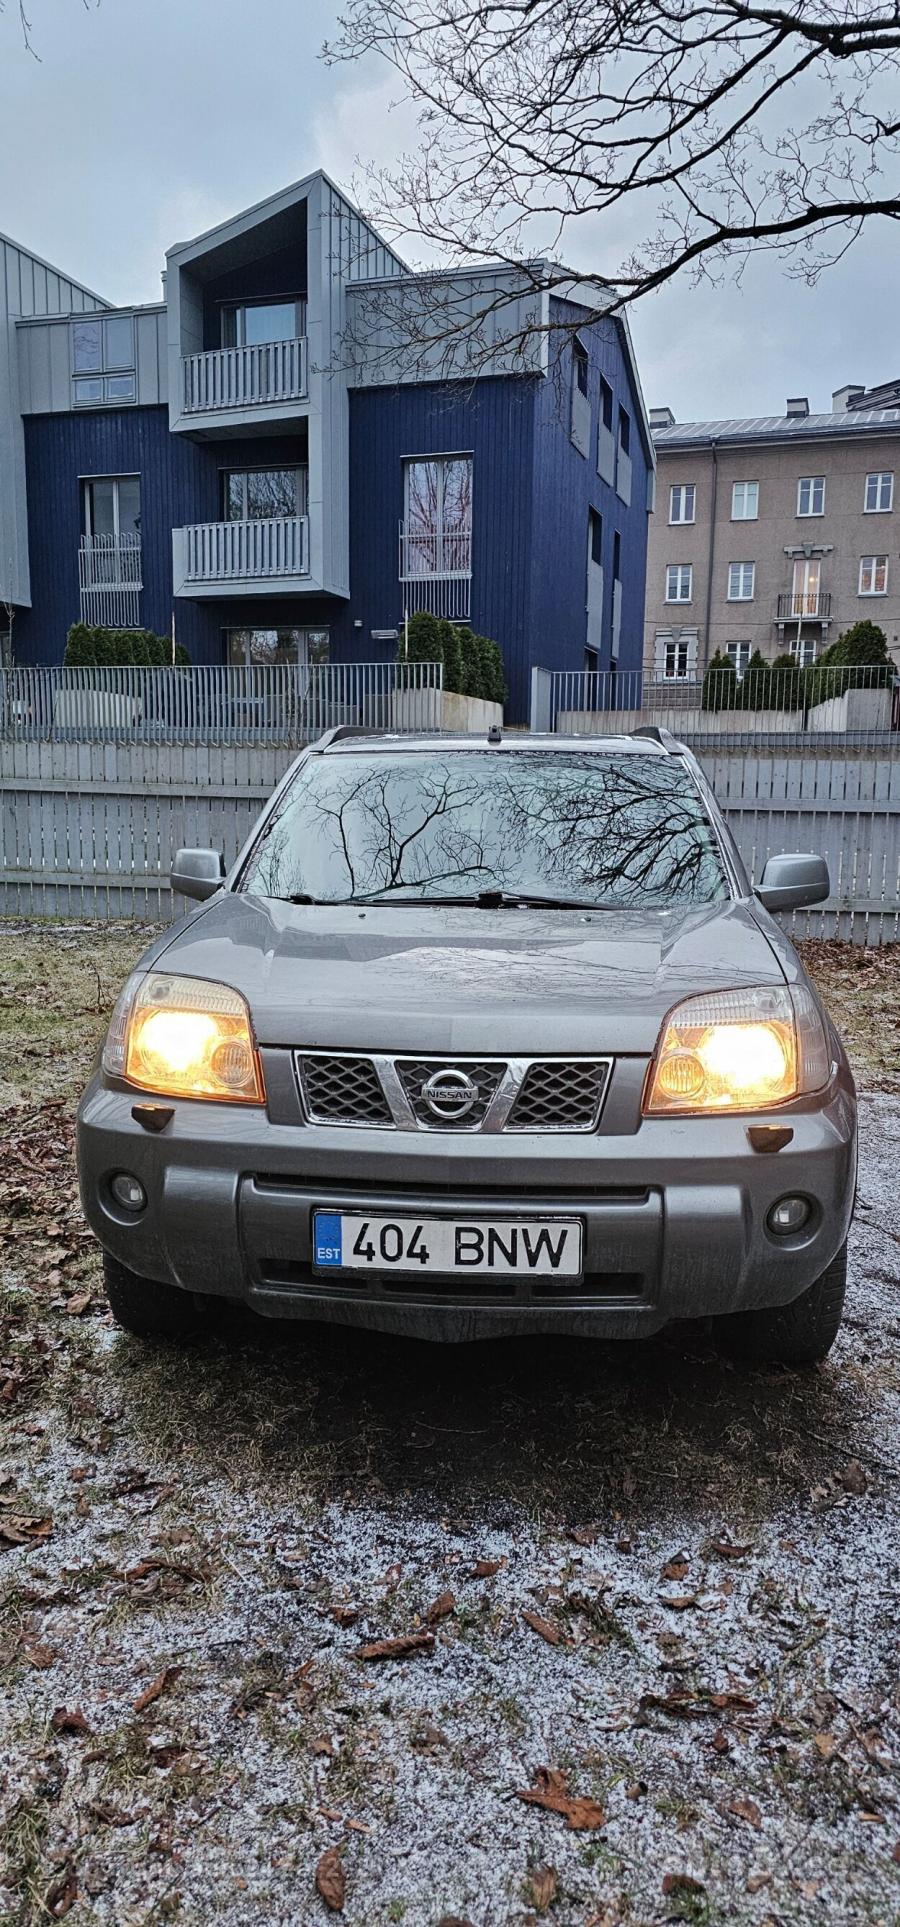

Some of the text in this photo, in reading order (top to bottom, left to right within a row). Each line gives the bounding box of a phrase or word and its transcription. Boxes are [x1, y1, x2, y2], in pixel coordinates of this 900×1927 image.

[428, 1090, 472, 1099] NISSAN
[352, 1222, 569, 1268] 404 BNW
[317, 1247, 341, 1259] EST
